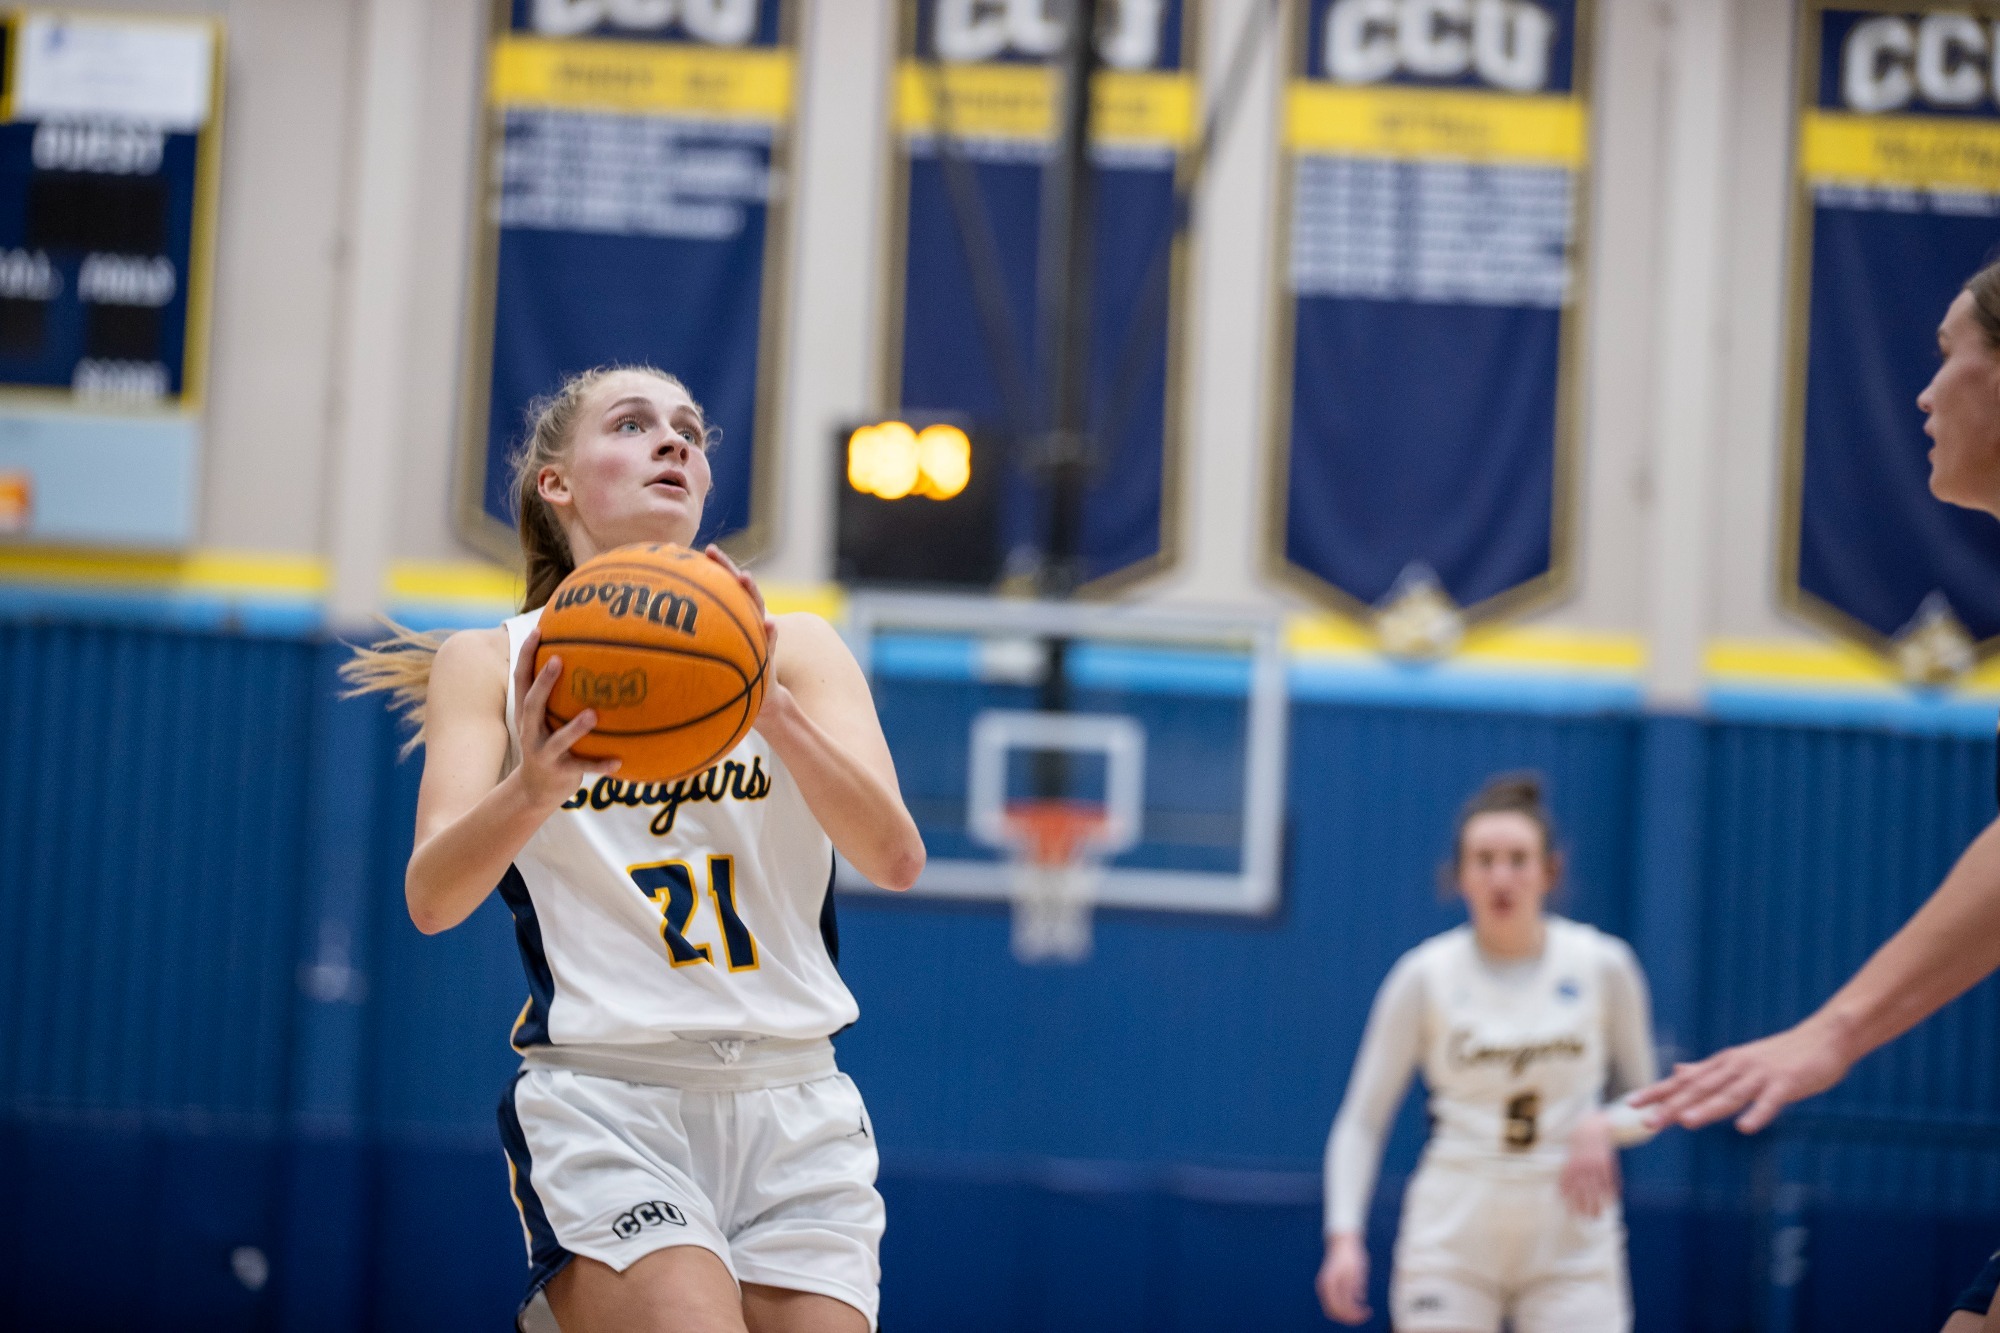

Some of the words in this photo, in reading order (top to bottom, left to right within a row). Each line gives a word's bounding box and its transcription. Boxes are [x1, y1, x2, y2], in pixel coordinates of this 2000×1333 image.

[1323, 0, 1555, 91] CCU
[1842, 11, 2000, 113] CC
[554, 581, 698, 637] Wilson
[560, 756, 771, 836] ougars
[626, 854, 760, 973] 21
[1503, 1091, 1540, 1153] 5
[612, 1200, 687, 1240] CCU
